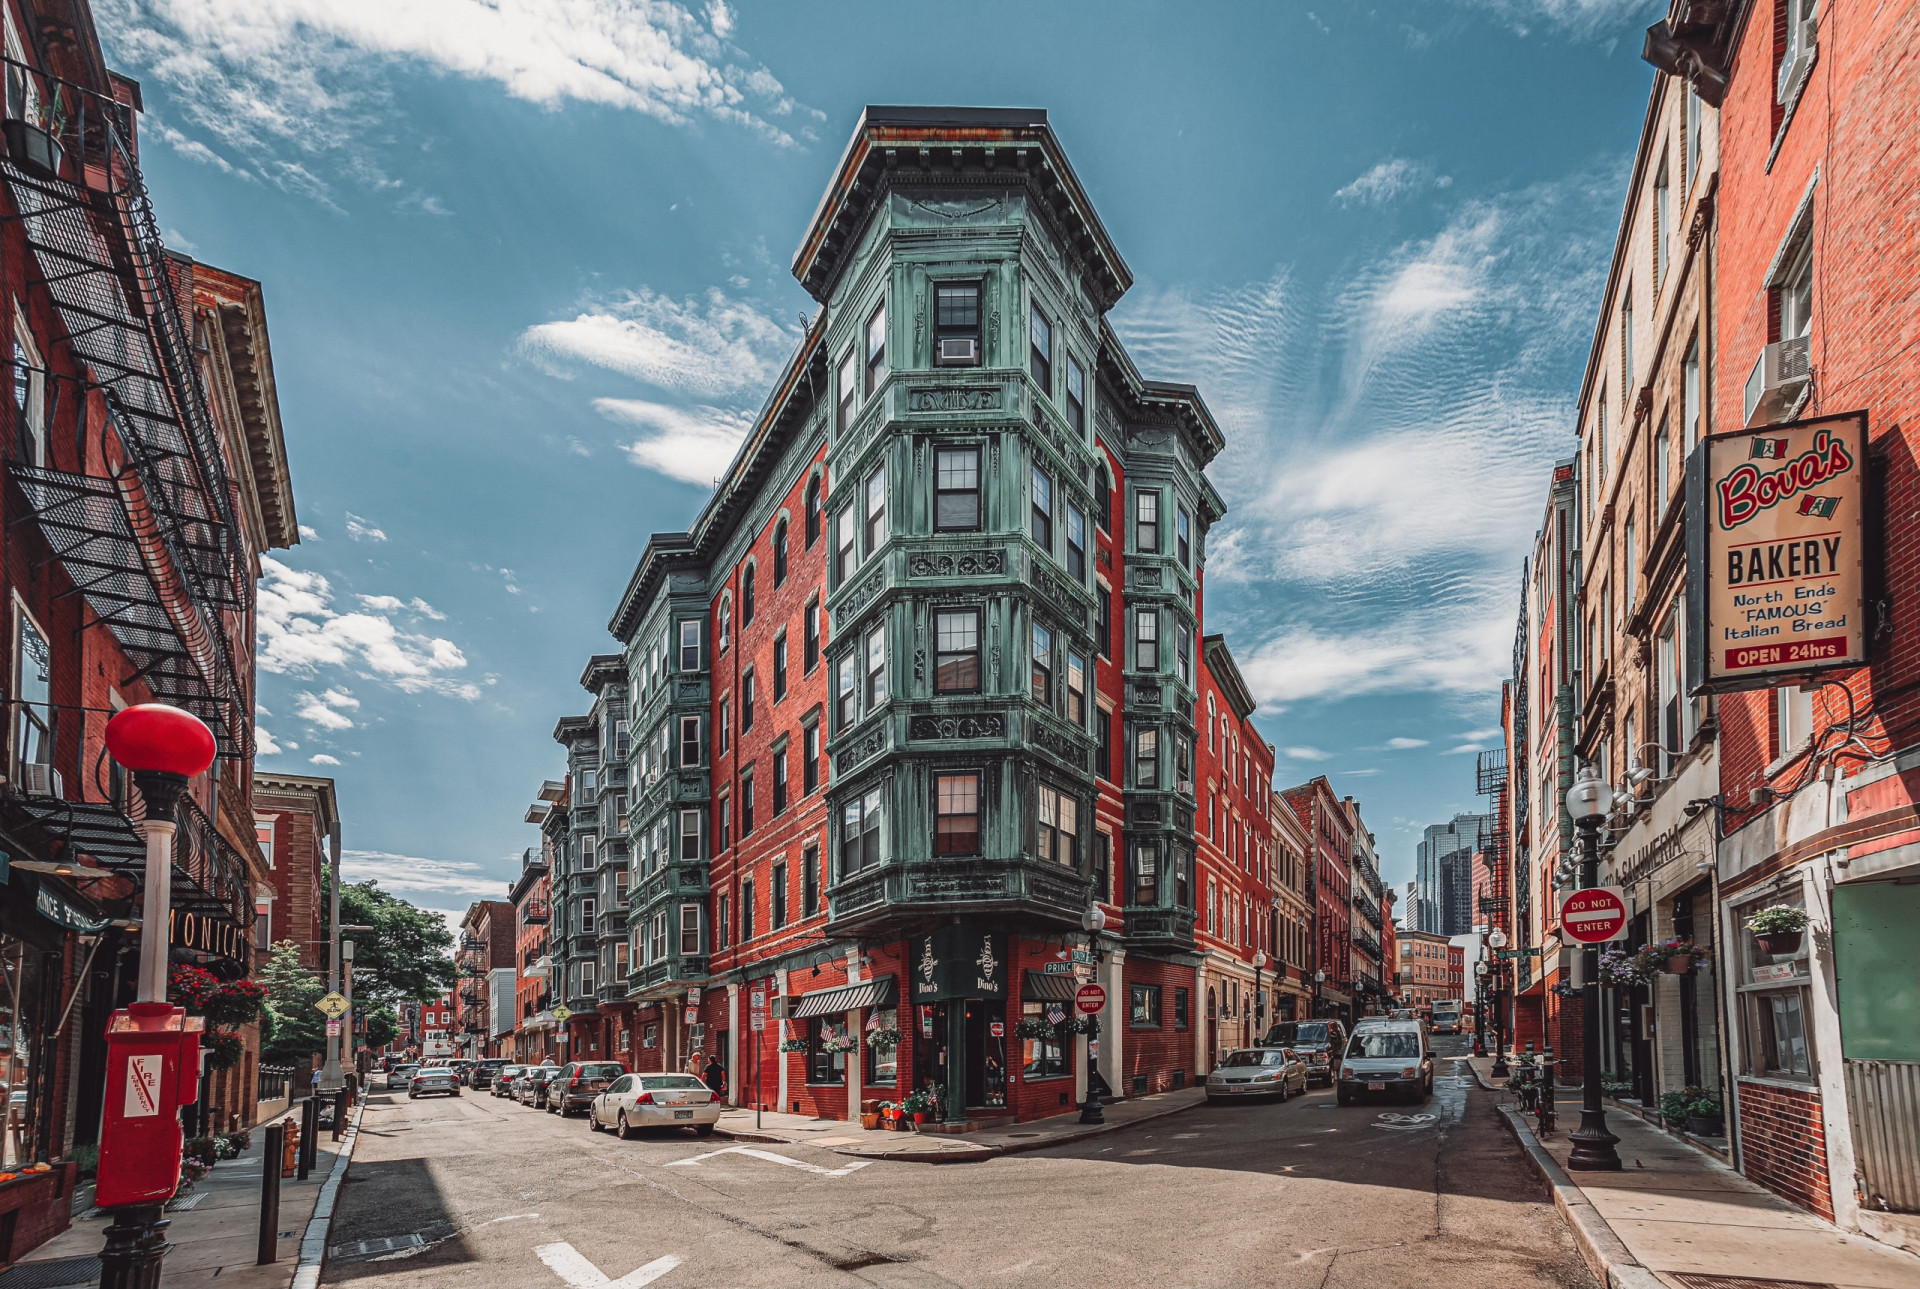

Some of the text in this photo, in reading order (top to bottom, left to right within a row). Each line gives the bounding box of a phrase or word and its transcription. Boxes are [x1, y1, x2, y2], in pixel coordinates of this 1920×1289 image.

[1716, 429, 1853, 530] Bova's
[1728, 537, 1840, 585] BAKERY
[1733, 581, 1836, 607] North End's
[1741, 600, 1828, 622] "FAMOUS"
[1724, 615, 1846, 640] Italian Bread
[1737, 642, 1836, 666] OPEN 24hrs
[1622, 823, 1682, 888] SALUMERIA
[1571, 898, 1612, 910] DO NOT
[1577, 921, 1611, 932] ENTER
[918, 980, 938, 994] Dino's
[977, 977, 999, 993] Dino's
[136, 1058, 156, 1087] FIRE
[131, 1075, 150, 1112] EMERGENCY
